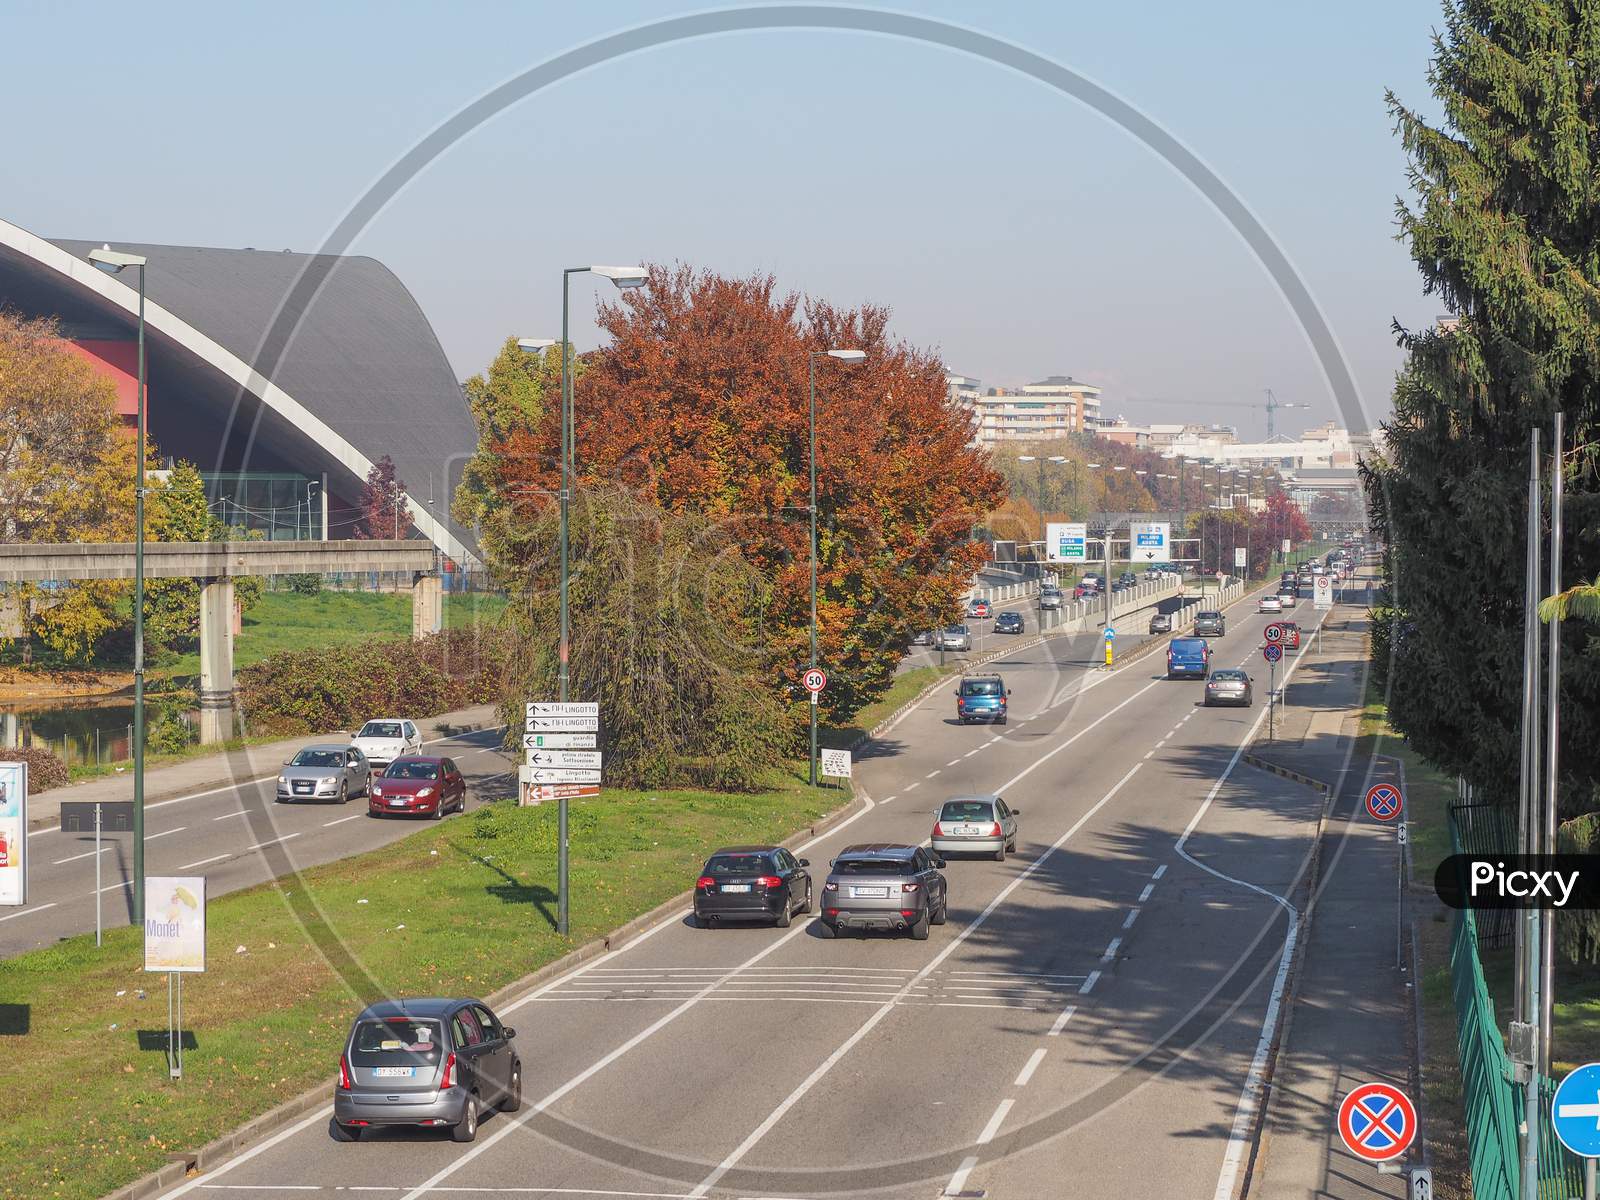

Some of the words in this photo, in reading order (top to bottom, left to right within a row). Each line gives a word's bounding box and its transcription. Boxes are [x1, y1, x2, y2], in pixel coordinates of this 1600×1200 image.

[1268, 629, 1279, 638] 50
[808, 676, 821, 686] 50
[146, 919, 180, 937] Monet
